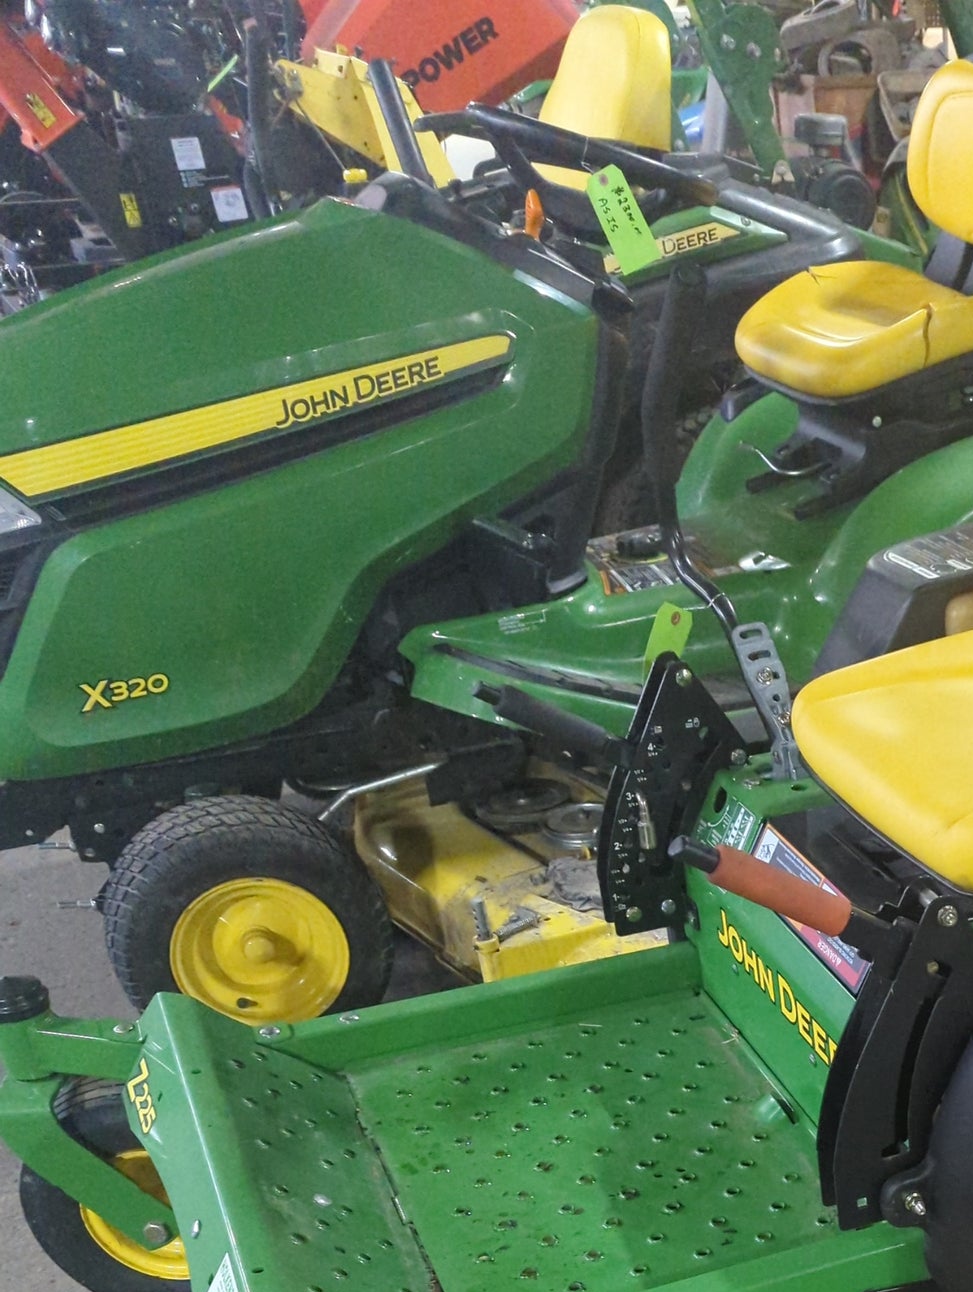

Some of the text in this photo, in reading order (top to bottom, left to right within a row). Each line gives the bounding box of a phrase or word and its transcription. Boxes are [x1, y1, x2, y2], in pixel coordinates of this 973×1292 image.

[661, 227, 719, 255] DEERE
[276, 356, 442, 426] JOHN DEERE
[79, 673, 169, 713] X320
[717, 907, 776, 1005] JOHN
[127, 1057, 157, 1135] Z225
